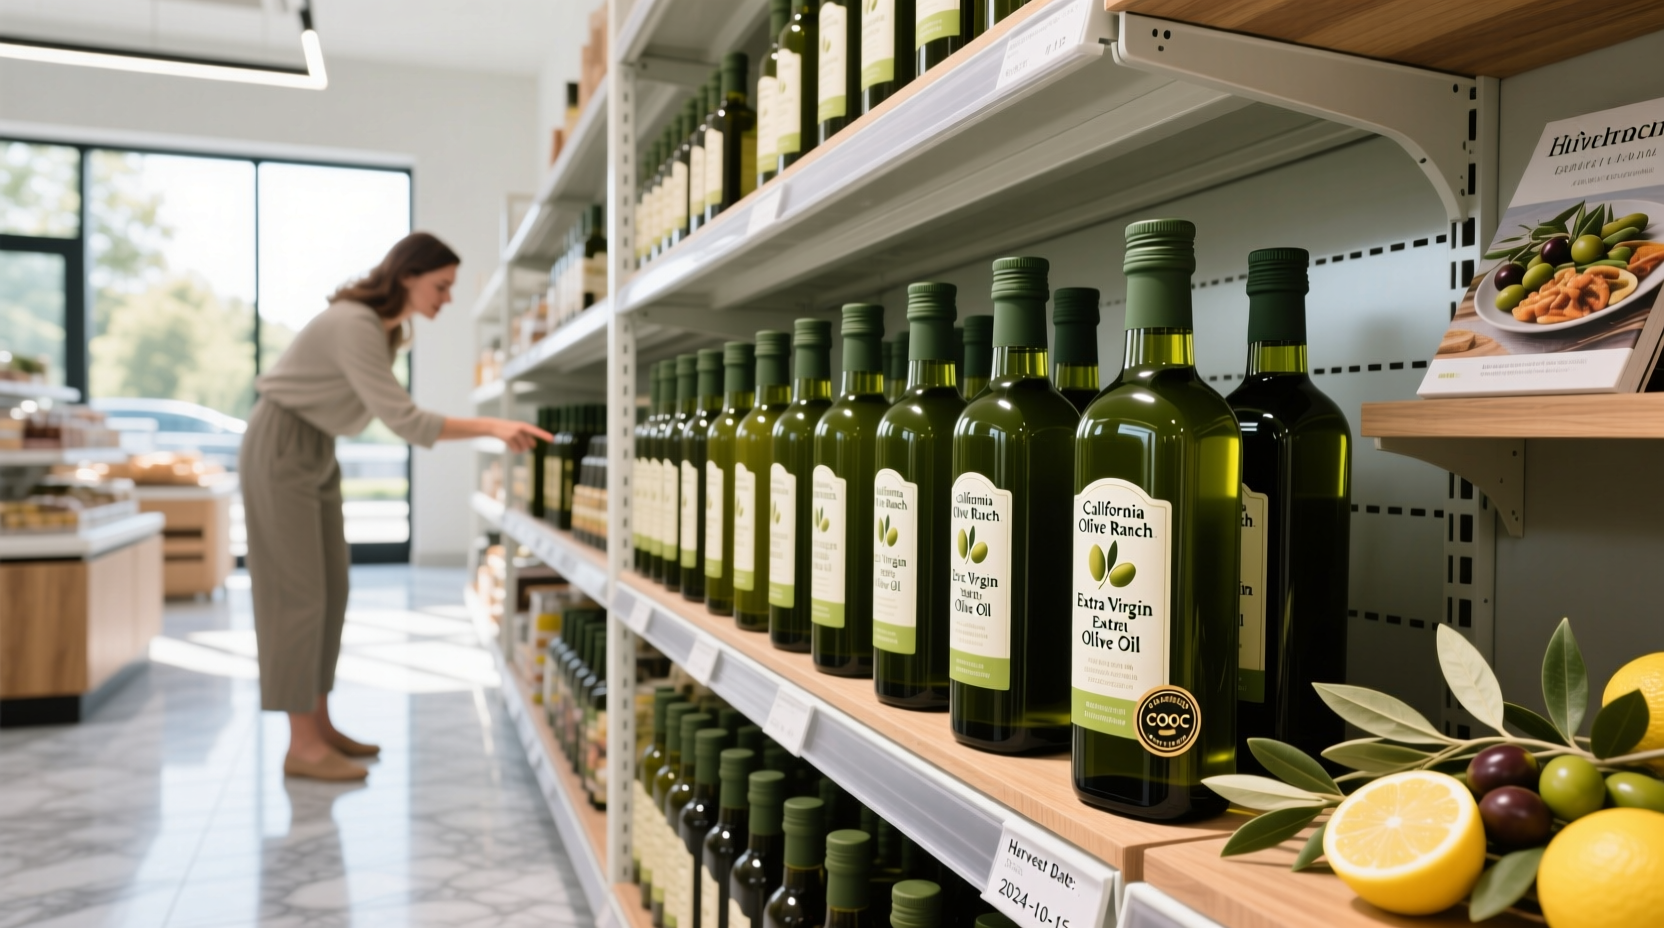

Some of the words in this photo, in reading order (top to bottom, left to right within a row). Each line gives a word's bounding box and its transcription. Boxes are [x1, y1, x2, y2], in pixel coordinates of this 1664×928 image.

[1079, 518, 1107, 534] Olive
[1110, 521, 1153, 538] Ranch
[1107, 597, 1153, 620] Virgin
[1081, 630, 1114, 650] Olive
[1118, 635, 1140, 653] Oil
[1146, 713, 1191, 728] COOC
